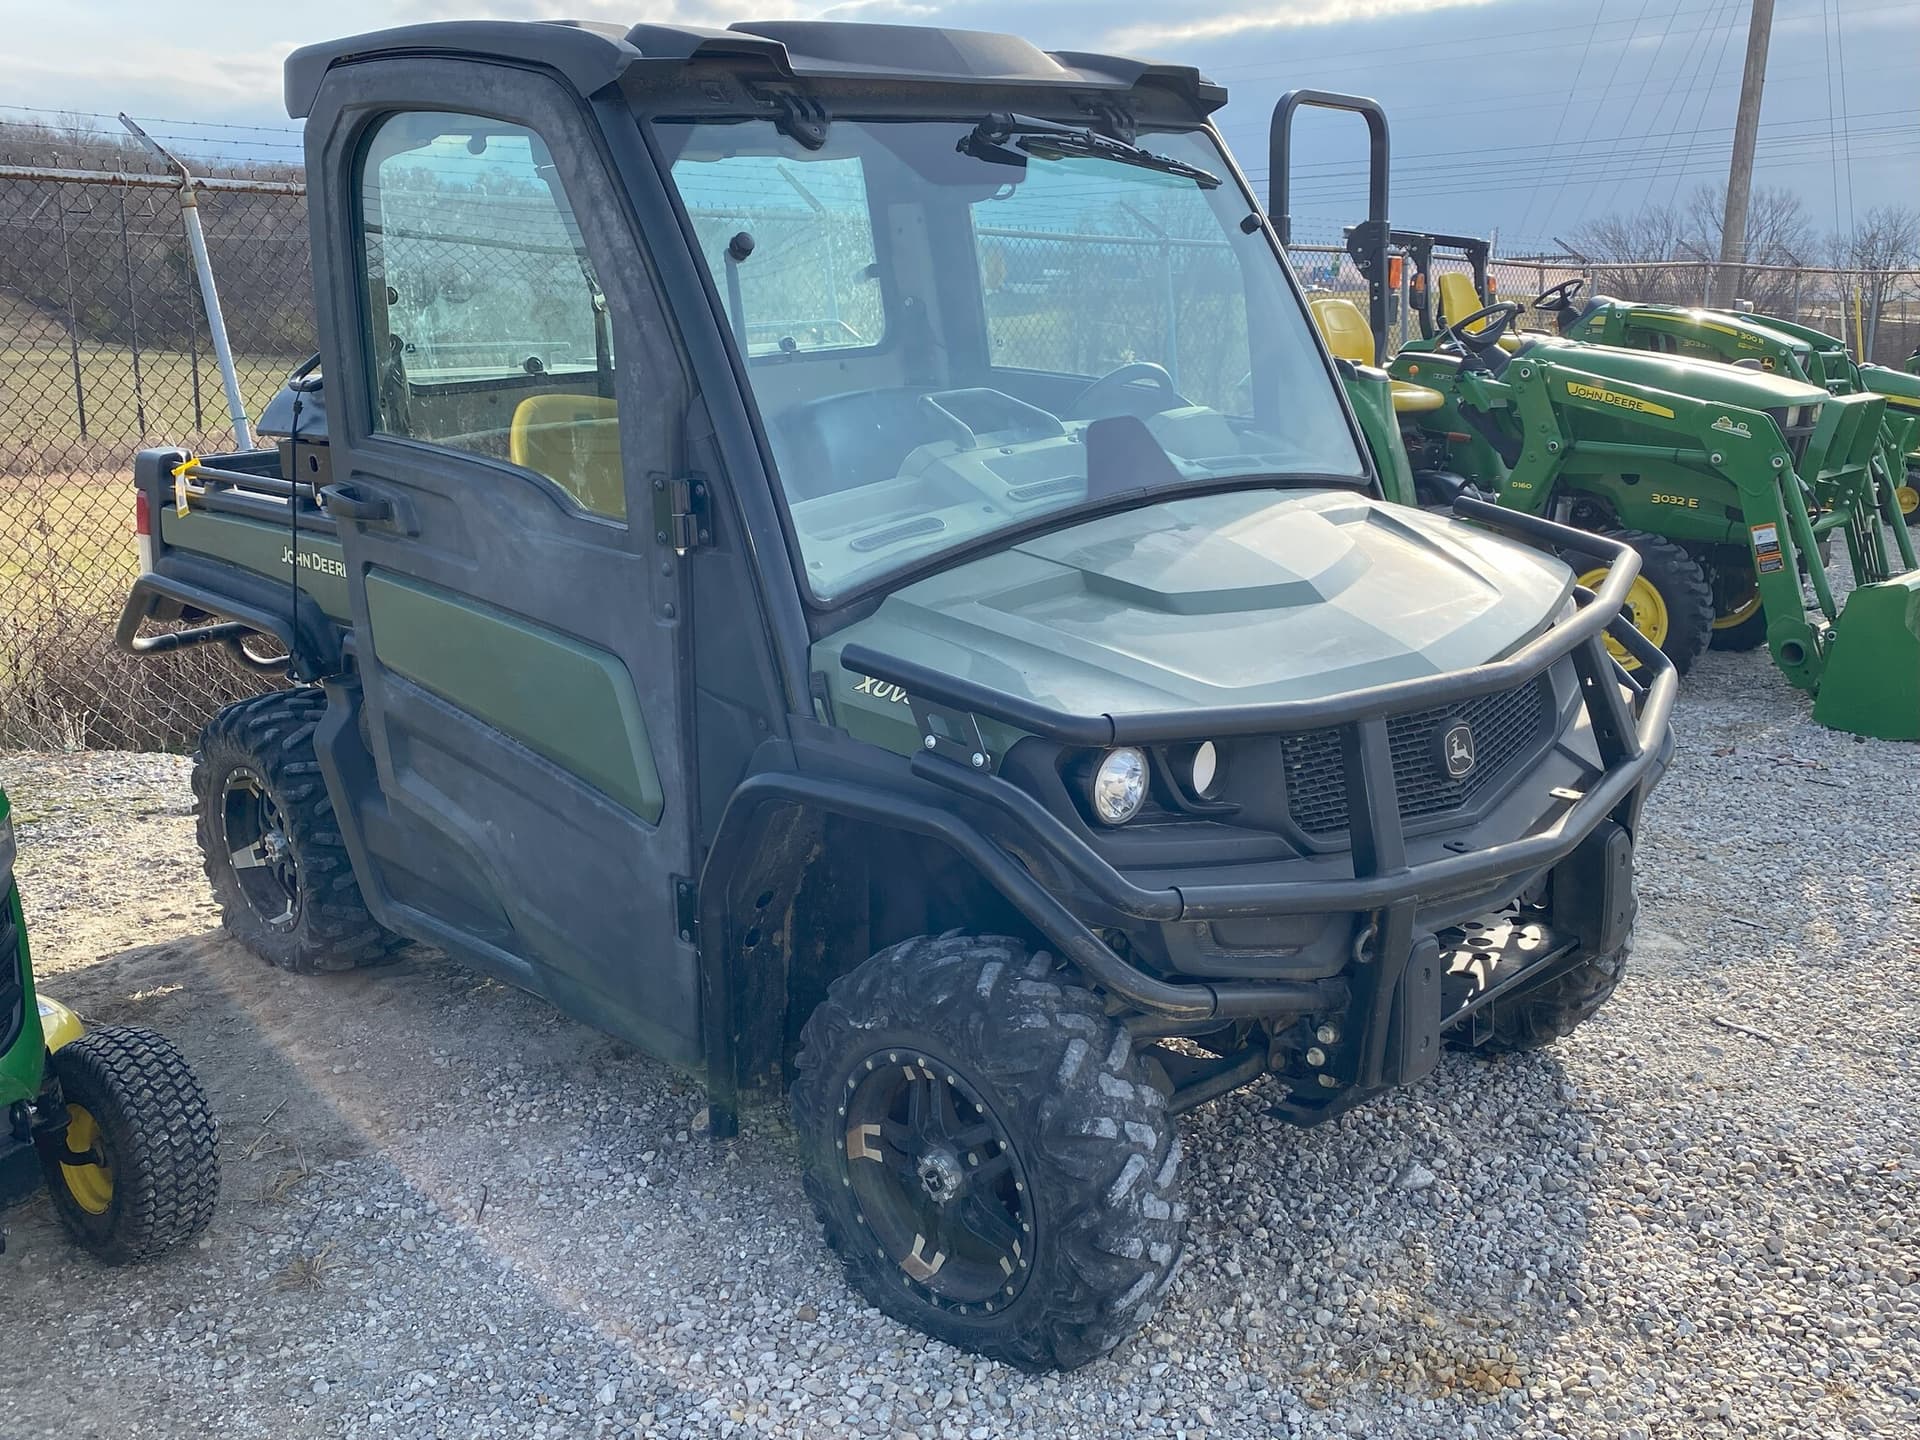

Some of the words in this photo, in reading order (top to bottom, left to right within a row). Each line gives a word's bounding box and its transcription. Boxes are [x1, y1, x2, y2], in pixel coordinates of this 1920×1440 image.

[1571, 385, 1603, 401] JOHN
[1605, 392, 1643, 410] DEERE
[1651, 493, 1685, 506] 3032
[1688, 497, 1699, 508] E
[281, 545, 311, 569] JOHN
[853, 675, 910, 705] XUV
